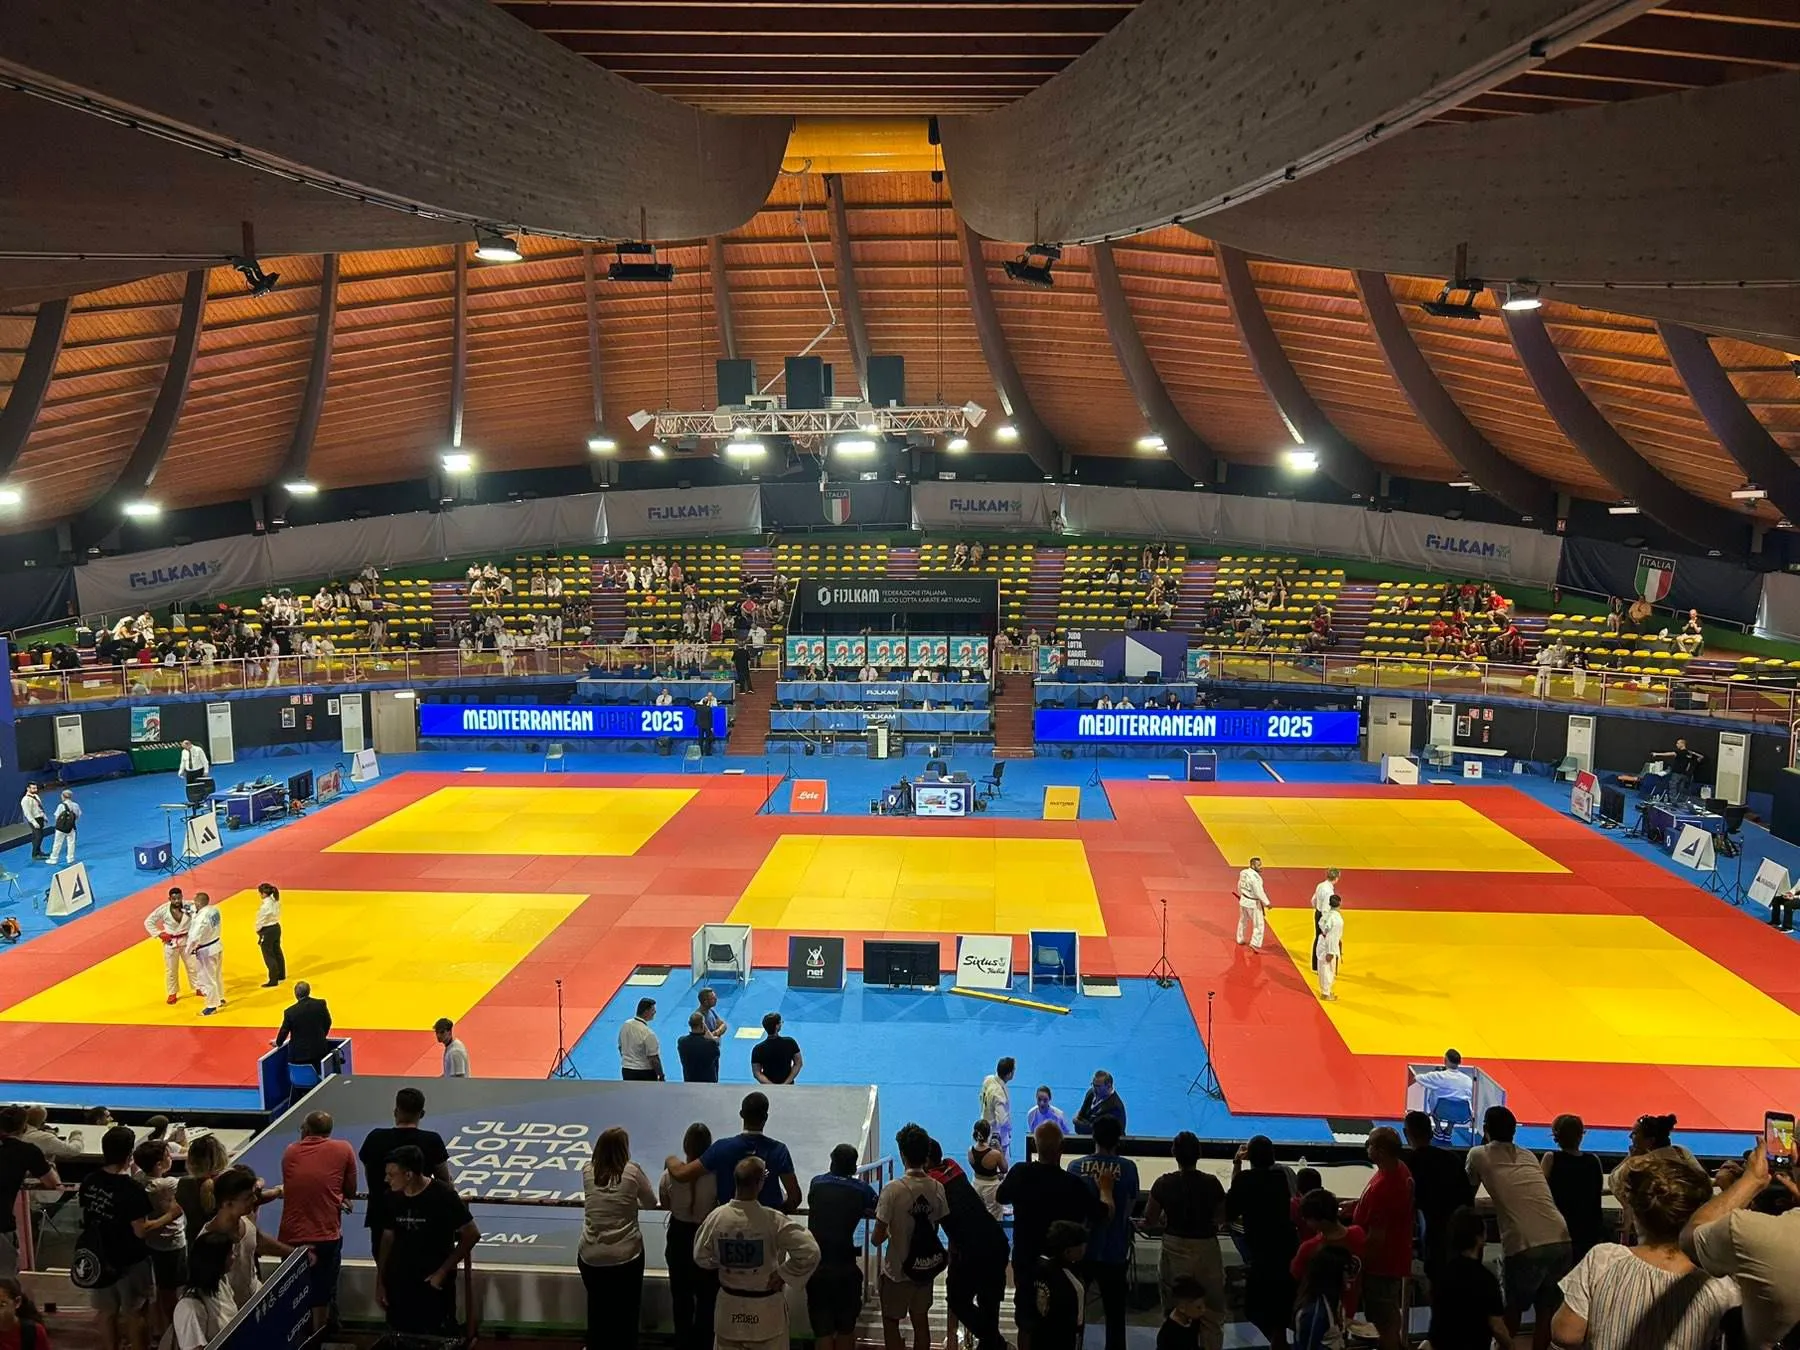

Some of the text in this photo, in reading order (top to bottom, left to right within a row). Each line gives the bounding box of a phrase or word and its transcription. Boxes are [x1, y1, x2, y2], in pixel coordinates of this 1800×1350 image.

[1642, 558, 1672, 569] ITALIA
[834, 588, 879, 603] FIJLKAM
[1067, 631, 1081, 640] JUDO
[1067, 641, 1082, 649] LOTTA
[1067, 650, 1087, 658] KARATE
[463, 709, 594, 731] MEDITERRANEAN
[641, 711, 684, 732] 2025
[1079, 714, 1216, 736] MEDITERRANEAN
[1267, 715, 1313, 737] 2025
[949, 792, 963, 811] 3
[807, 968, 824, 976] net
[963, 955, 998, 973] Sixtus
[461, 1121, 589, 1137] JUDO
[446, 1136, 594, 1154] LOTTA
[447, 1153, 592, 1171] KARAT
[454, 1170, 534, 1186] RTI
[726, 1242, 756, 1263] ESP
[293, 1285, 309, 1310] BAR
[731, 1313, 760, 1324] PEDRO
